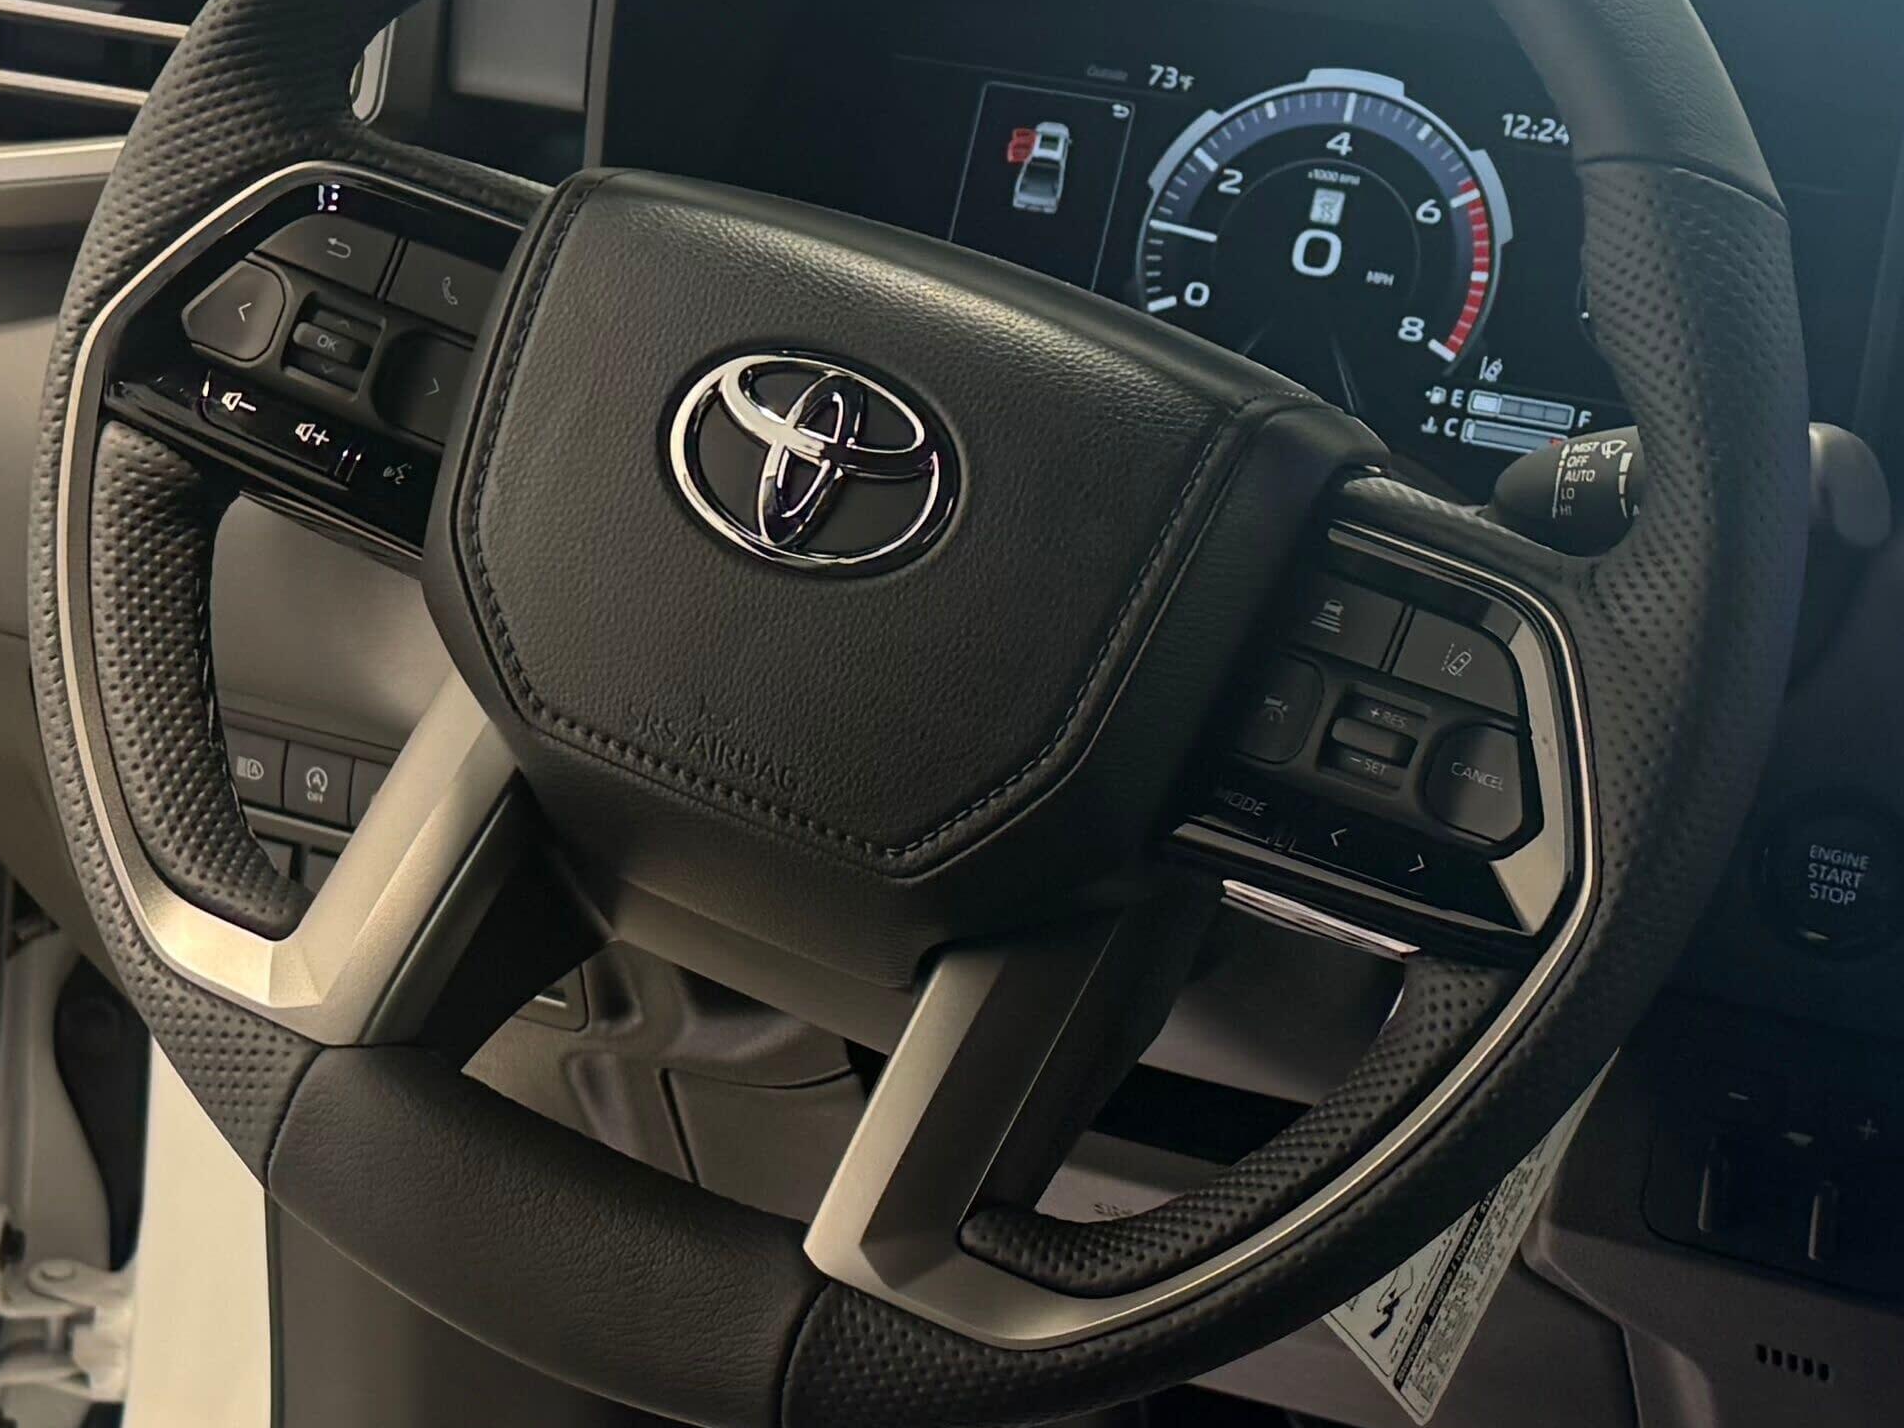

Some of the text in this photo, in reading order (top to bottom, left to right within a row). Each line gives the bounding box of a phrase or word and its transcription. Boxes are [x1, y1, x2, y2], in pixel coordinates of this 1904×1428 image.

[1501, 113, 1570, 145] 12:24
[1325, 131, 1353, 156] 4
[1216, 168, 1245, 195] 2
[1415, 199, 1443, 225] 6
[1291, 228, 1342, 276] 0
[1183, 280, 1211, 308] 0
[1398, 315, 1425, 343] 8
[316, 334, 337, 352] OK
[1450, 388, 1464, 410] E
[1443, 417, 1459, 438] C
[1578, 410, 1593, 429] F
[1570, 441, 1601, 454] MIST
[1566, 455, 1590, 468] OFF
[1564, 469, 1596, 482] AUTO
[1560, 487, 1575, 500] LO
[1449, 760, 1505, 793] CANCEL
[1808, 844, 1871, 872] ENGINE
[1807, 863, 1865, 889] START
[1809, 882, 1857, 906] STOP
